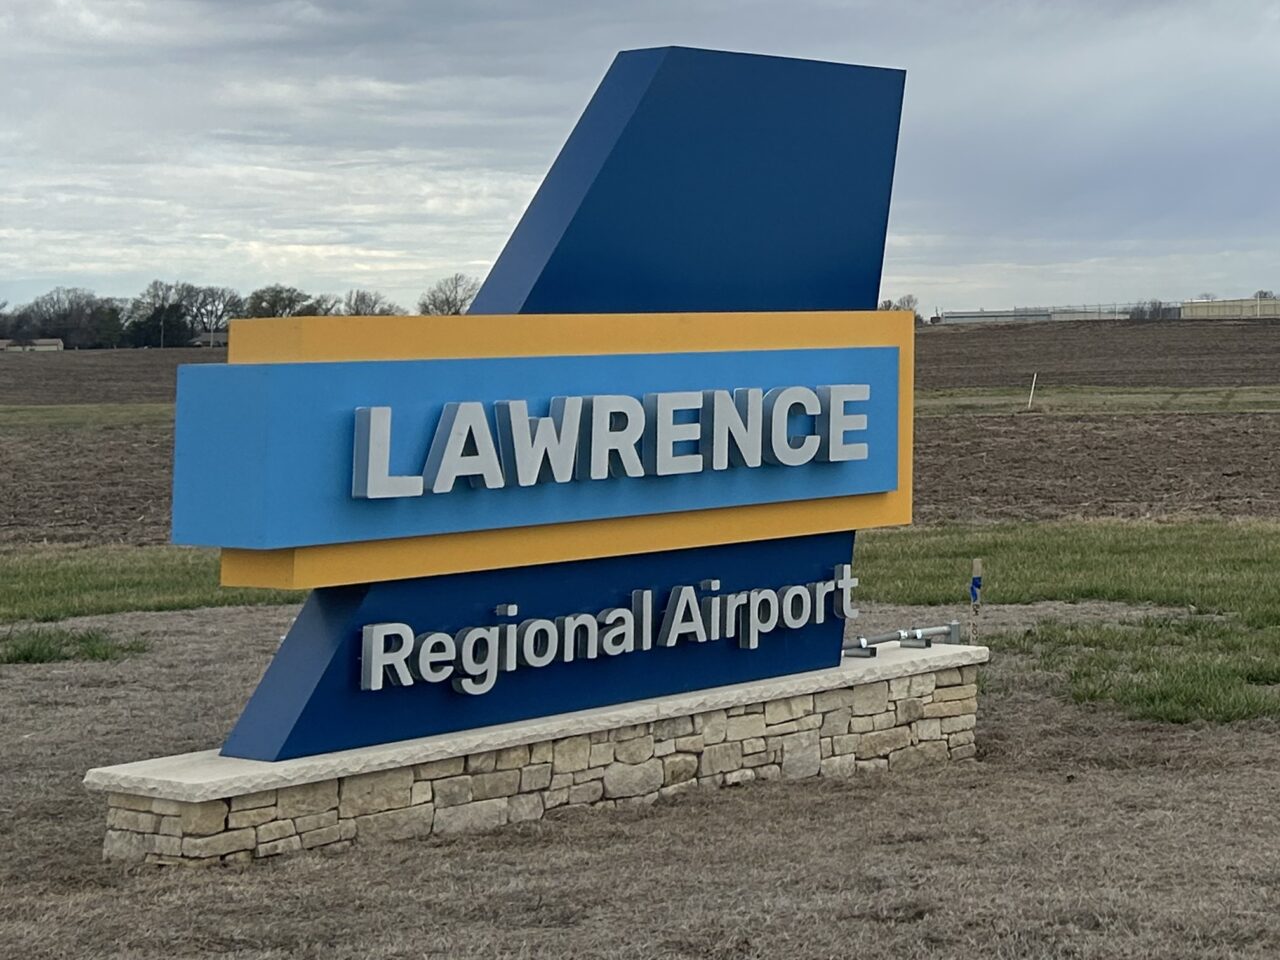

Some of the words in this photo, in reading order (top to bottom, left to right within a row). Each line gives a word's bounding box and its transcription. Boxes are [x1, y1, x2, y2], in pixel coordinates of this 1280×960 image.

[354, 384, 871, 499] LAWRENCE
[361, 589, 653, 695] Regional
[659, 563, 860, 648] Airport
